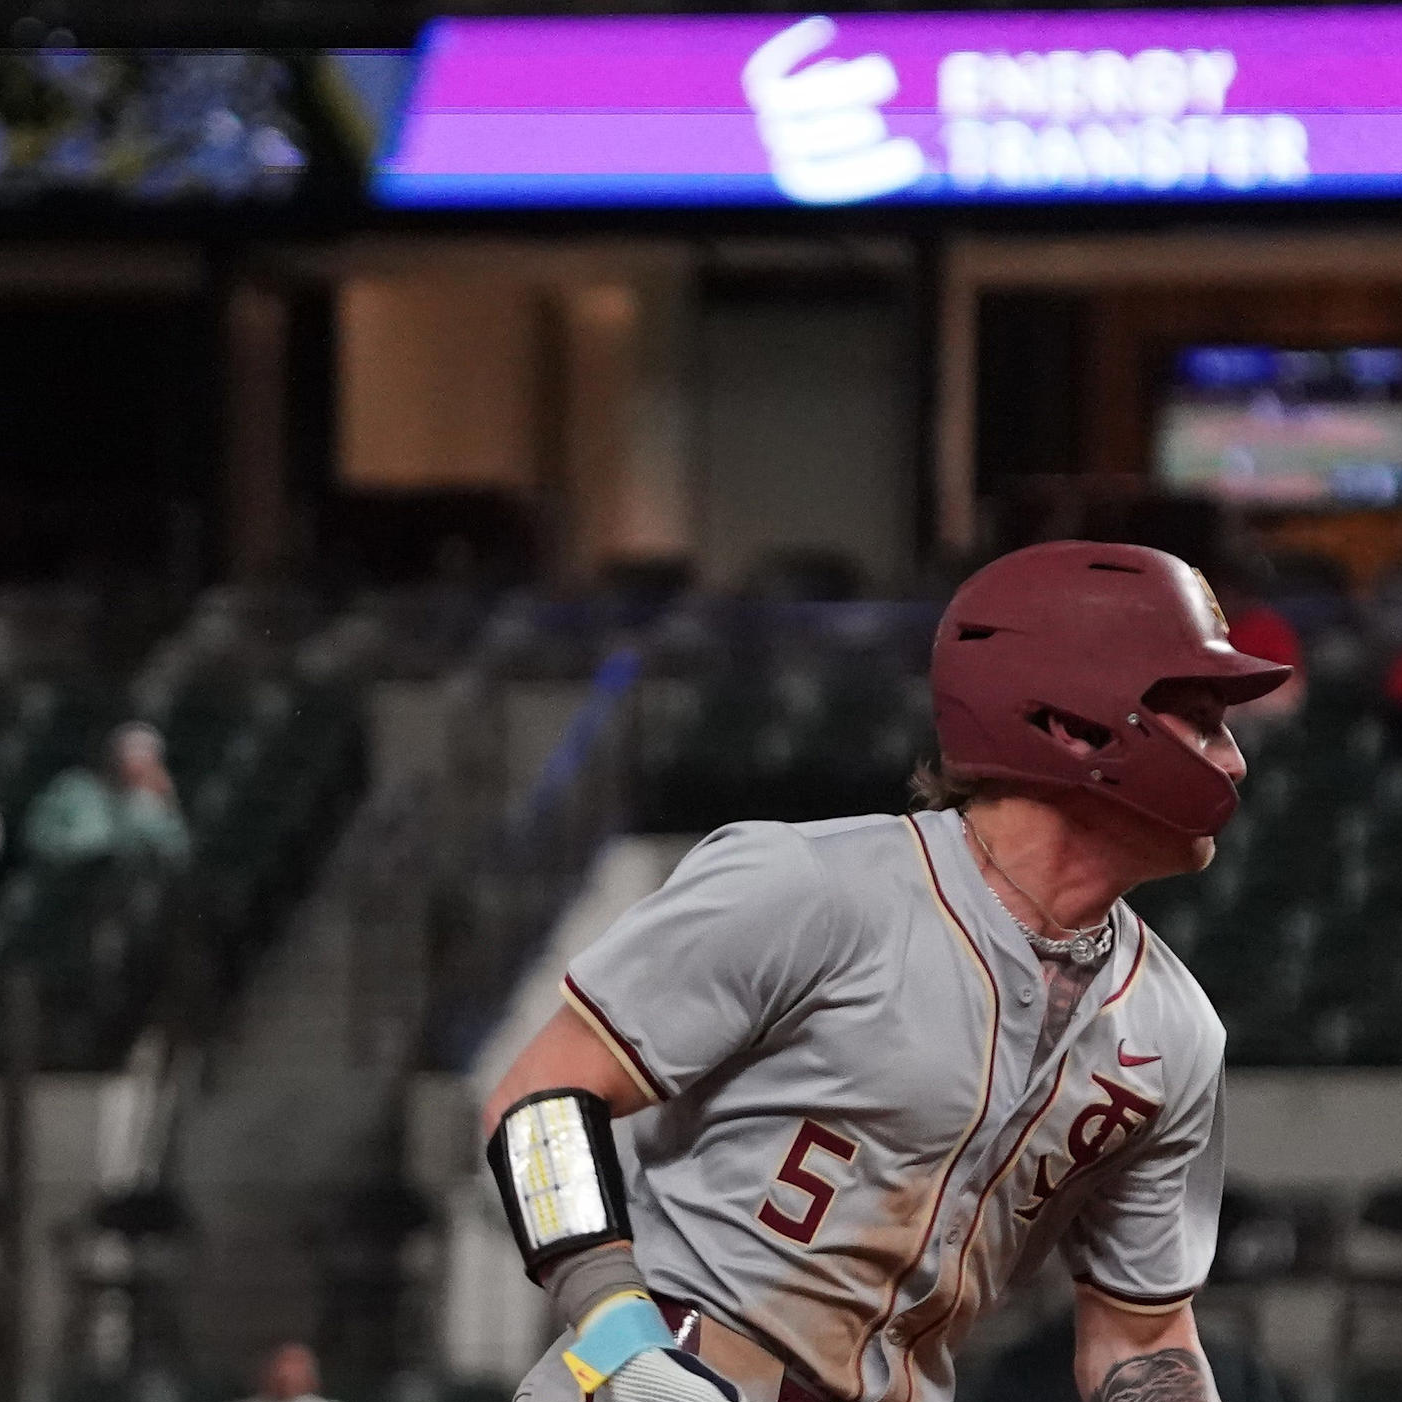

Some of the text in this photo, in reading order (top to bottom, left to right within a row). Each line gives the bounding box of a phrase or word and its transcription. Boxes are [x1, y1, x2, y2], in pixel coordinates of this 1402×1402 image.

[938, 48, 1237, 115] ENERGY
[942, 113, 1310, 192] TRANSFER
[755, 1117, 860, 1248] 5
